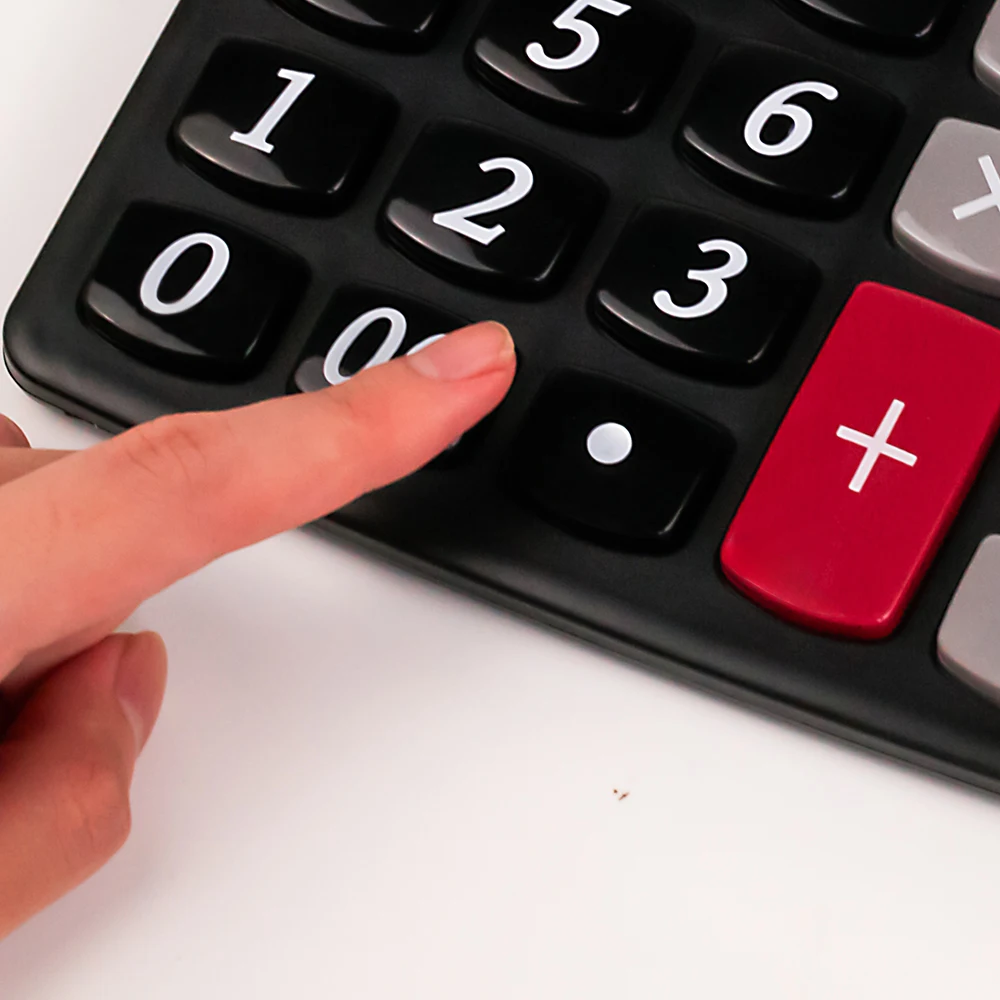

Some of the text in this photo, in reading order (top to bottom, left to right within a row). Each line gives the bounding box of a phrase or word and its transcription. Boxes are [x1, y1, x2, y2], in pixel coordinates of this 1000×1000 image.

[229, 67, 316, 154] 1
[744, 81, 839, 156] 6
[432, 157, 534, 245] 2
[140, 232, 230, 315] 0
[653, 239, 748, 318] 3
